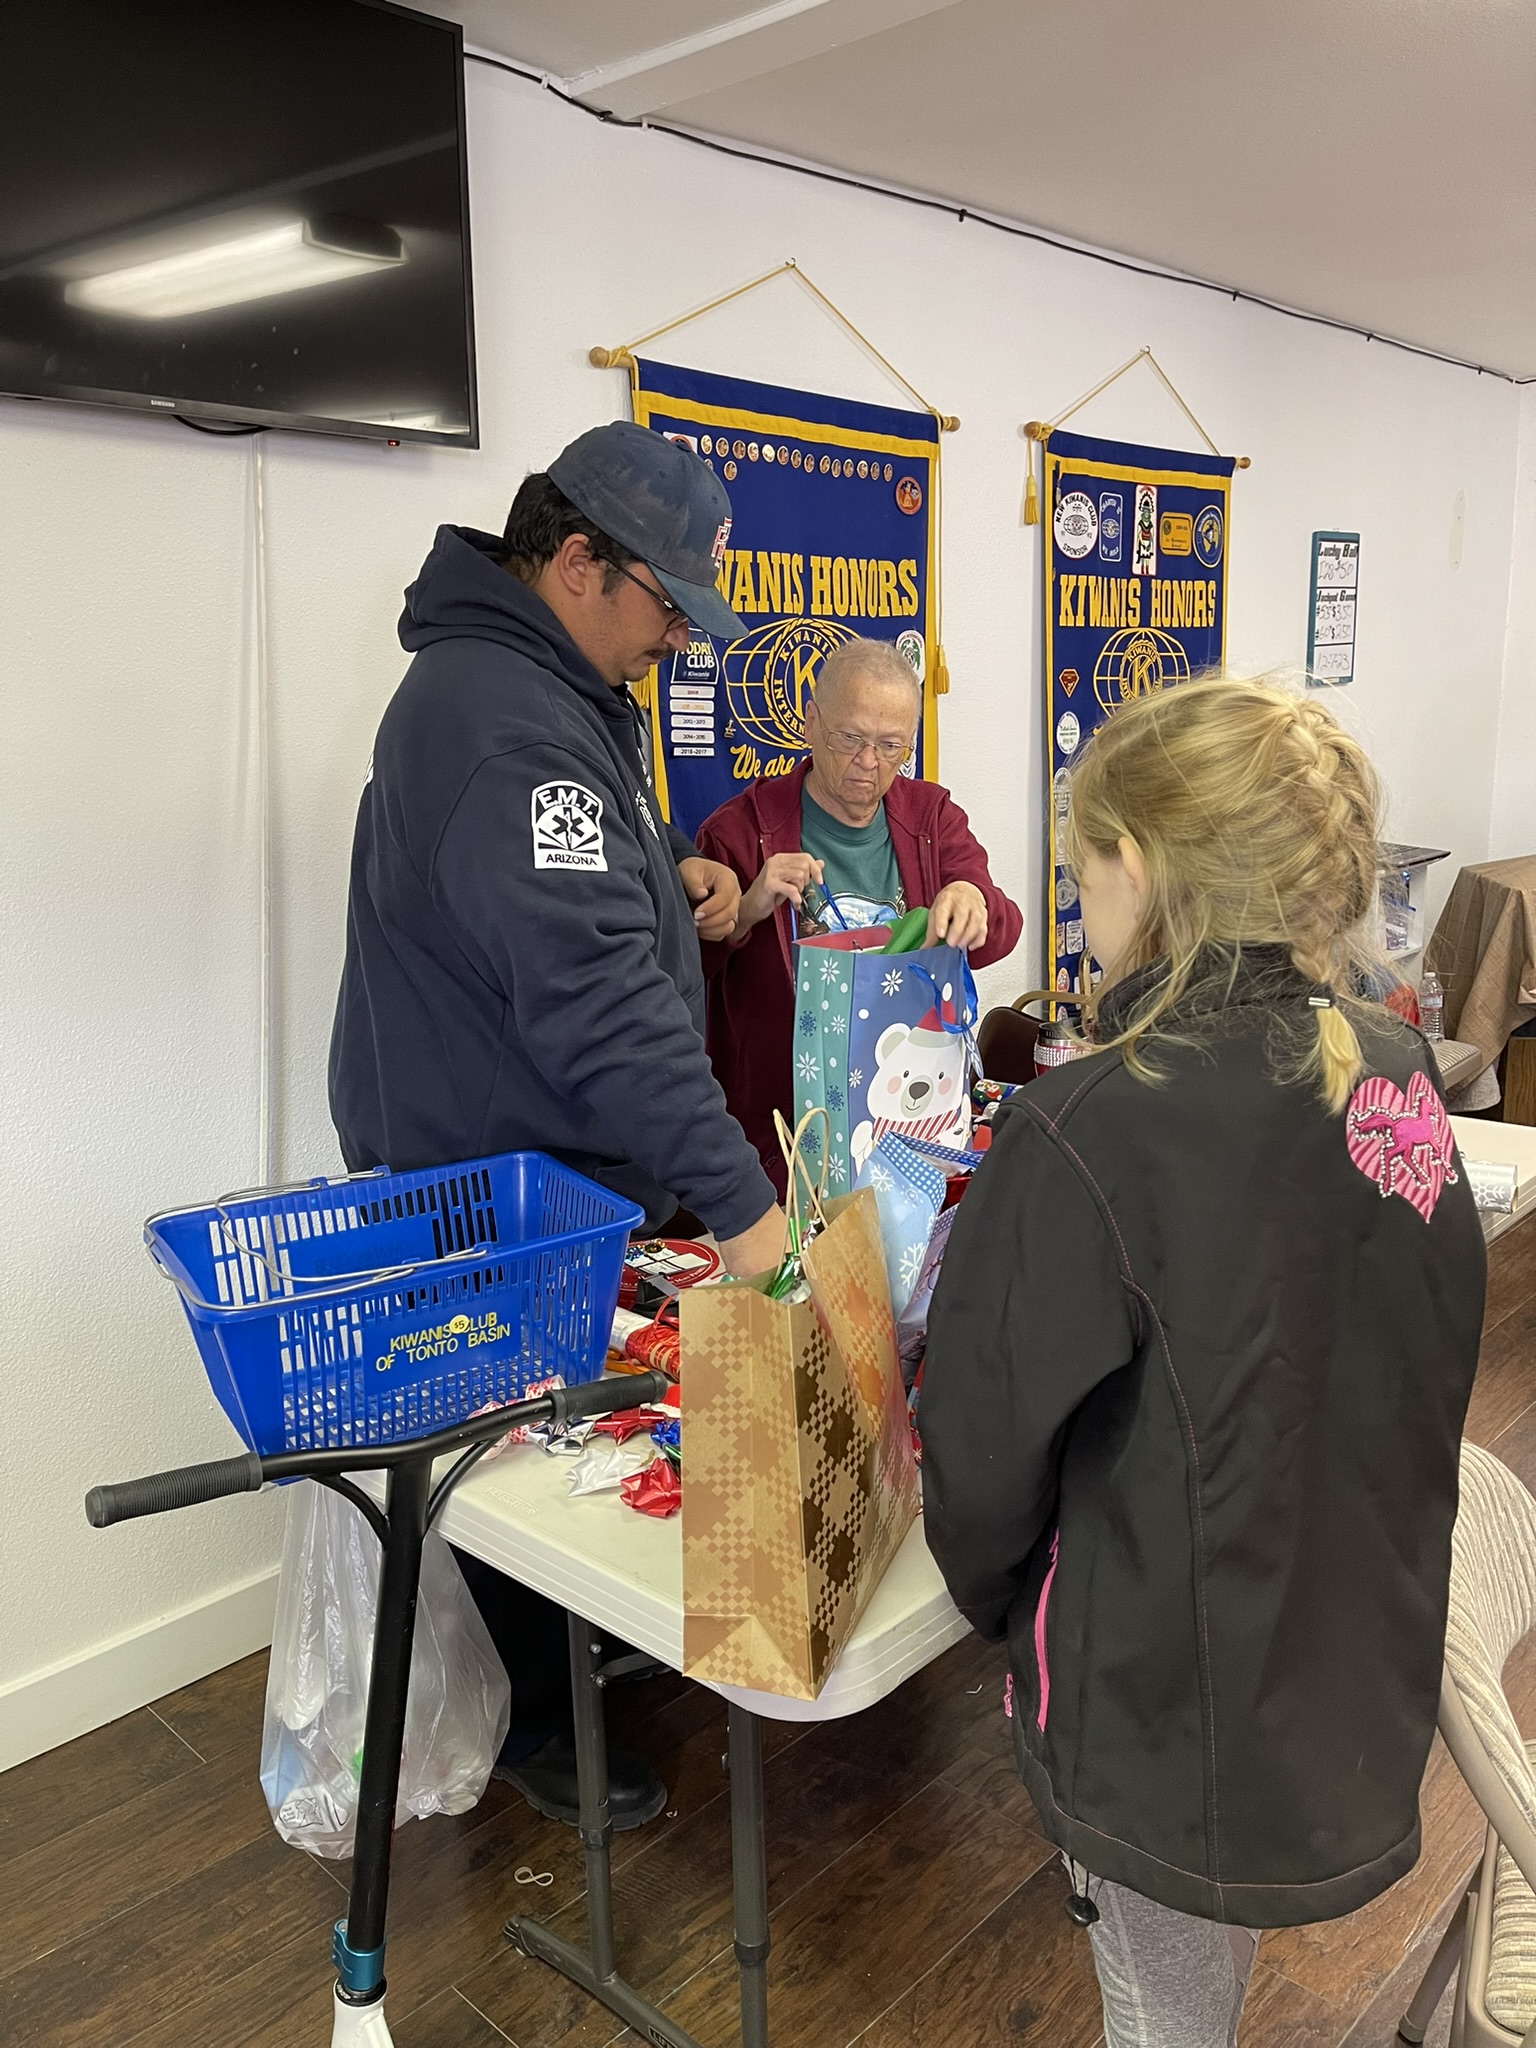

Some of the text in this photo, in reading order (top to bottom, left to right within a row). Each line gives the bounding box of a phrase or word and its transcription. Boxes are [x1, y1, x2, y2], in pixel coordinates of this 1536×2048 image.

[810, 555, 919, 618] HONORS
[1059, 574, 1217, 628] KIWANIS HONORS
[681, 641, 712, 655] ODAY
[686, 655, 715, 669] CLUB
[730, 744, 796, 780] We are
[546, 854, 598, 866] ARIZONA
[390, 1323, 452, 1352] KIWANIS
[453, 1319, 465, 1331] $5
[375, 1323, 511, 1372] OF TONTO BASIN
